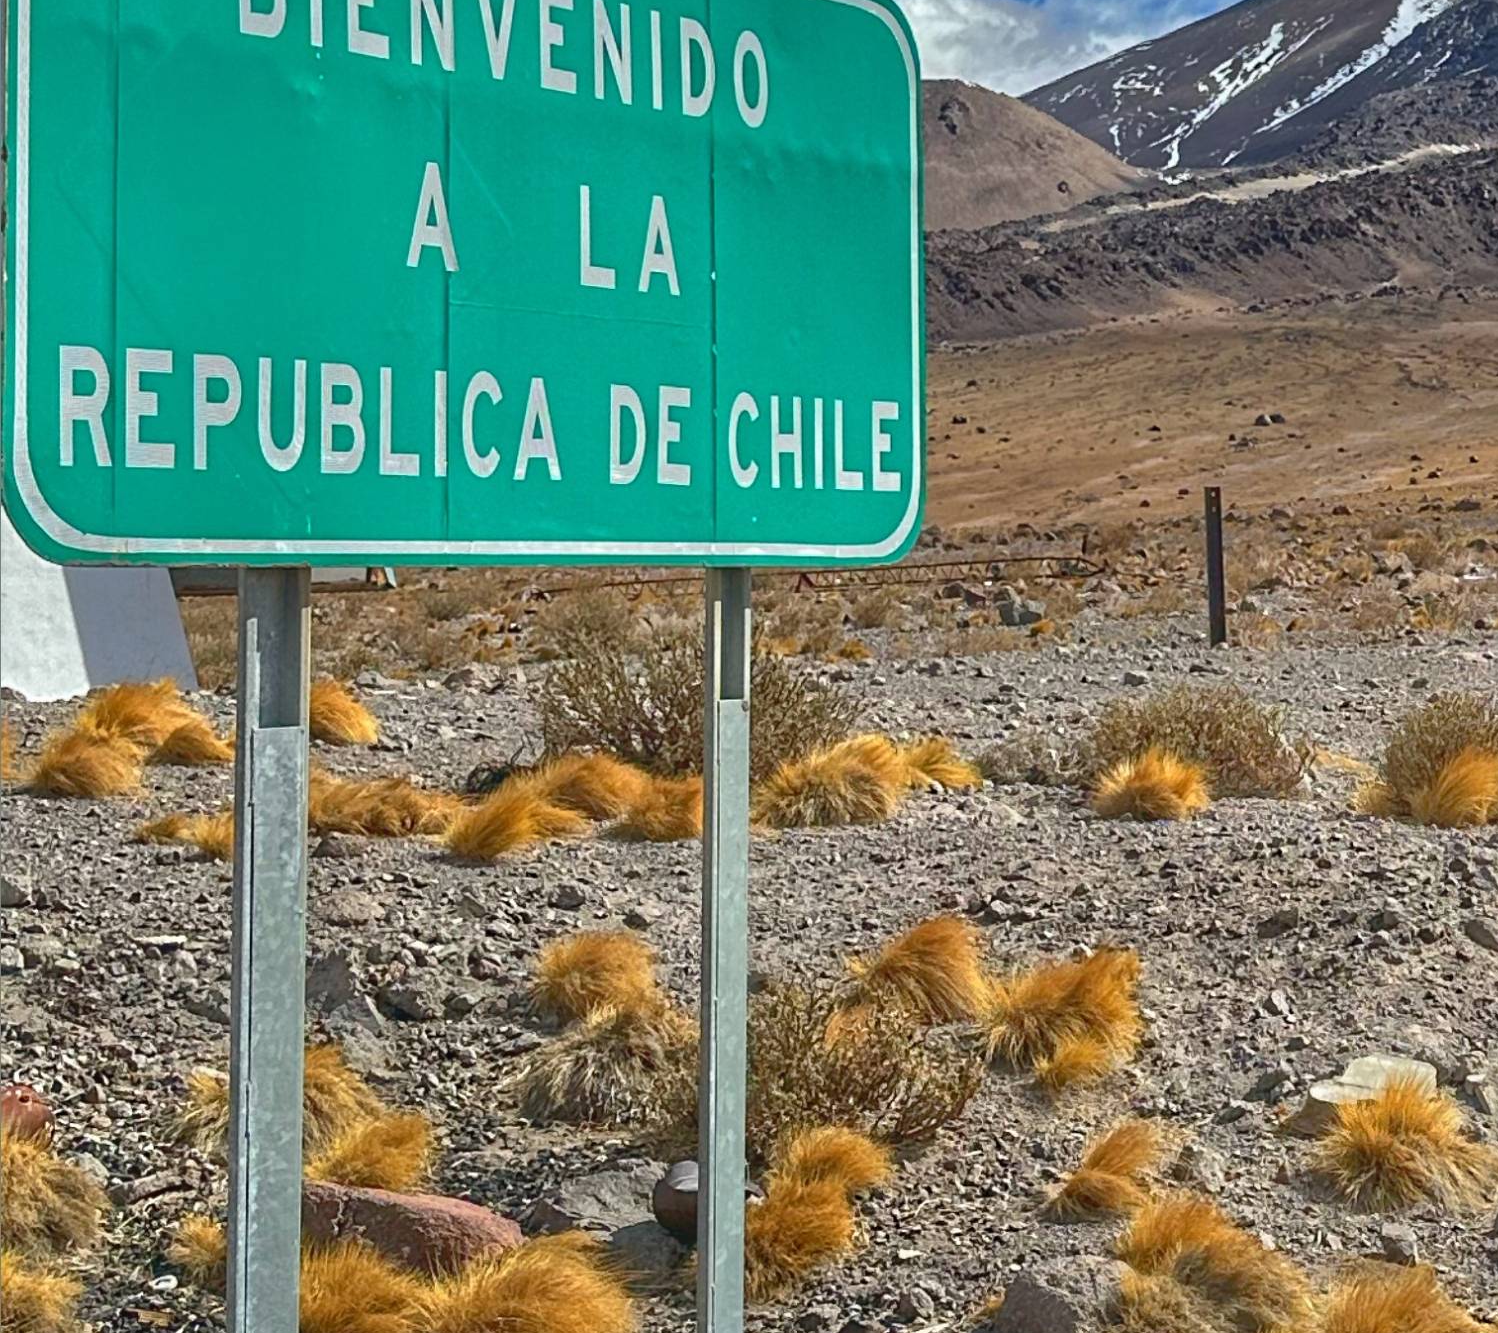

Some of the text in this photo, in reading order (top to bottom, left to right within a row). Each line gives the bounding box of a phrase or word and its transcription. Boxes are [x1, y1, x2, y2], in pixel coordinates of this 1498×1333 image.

[407, 161, 680, 295] A LA
[59, 344, 902, 492] REPUBLICA DE CHILE
